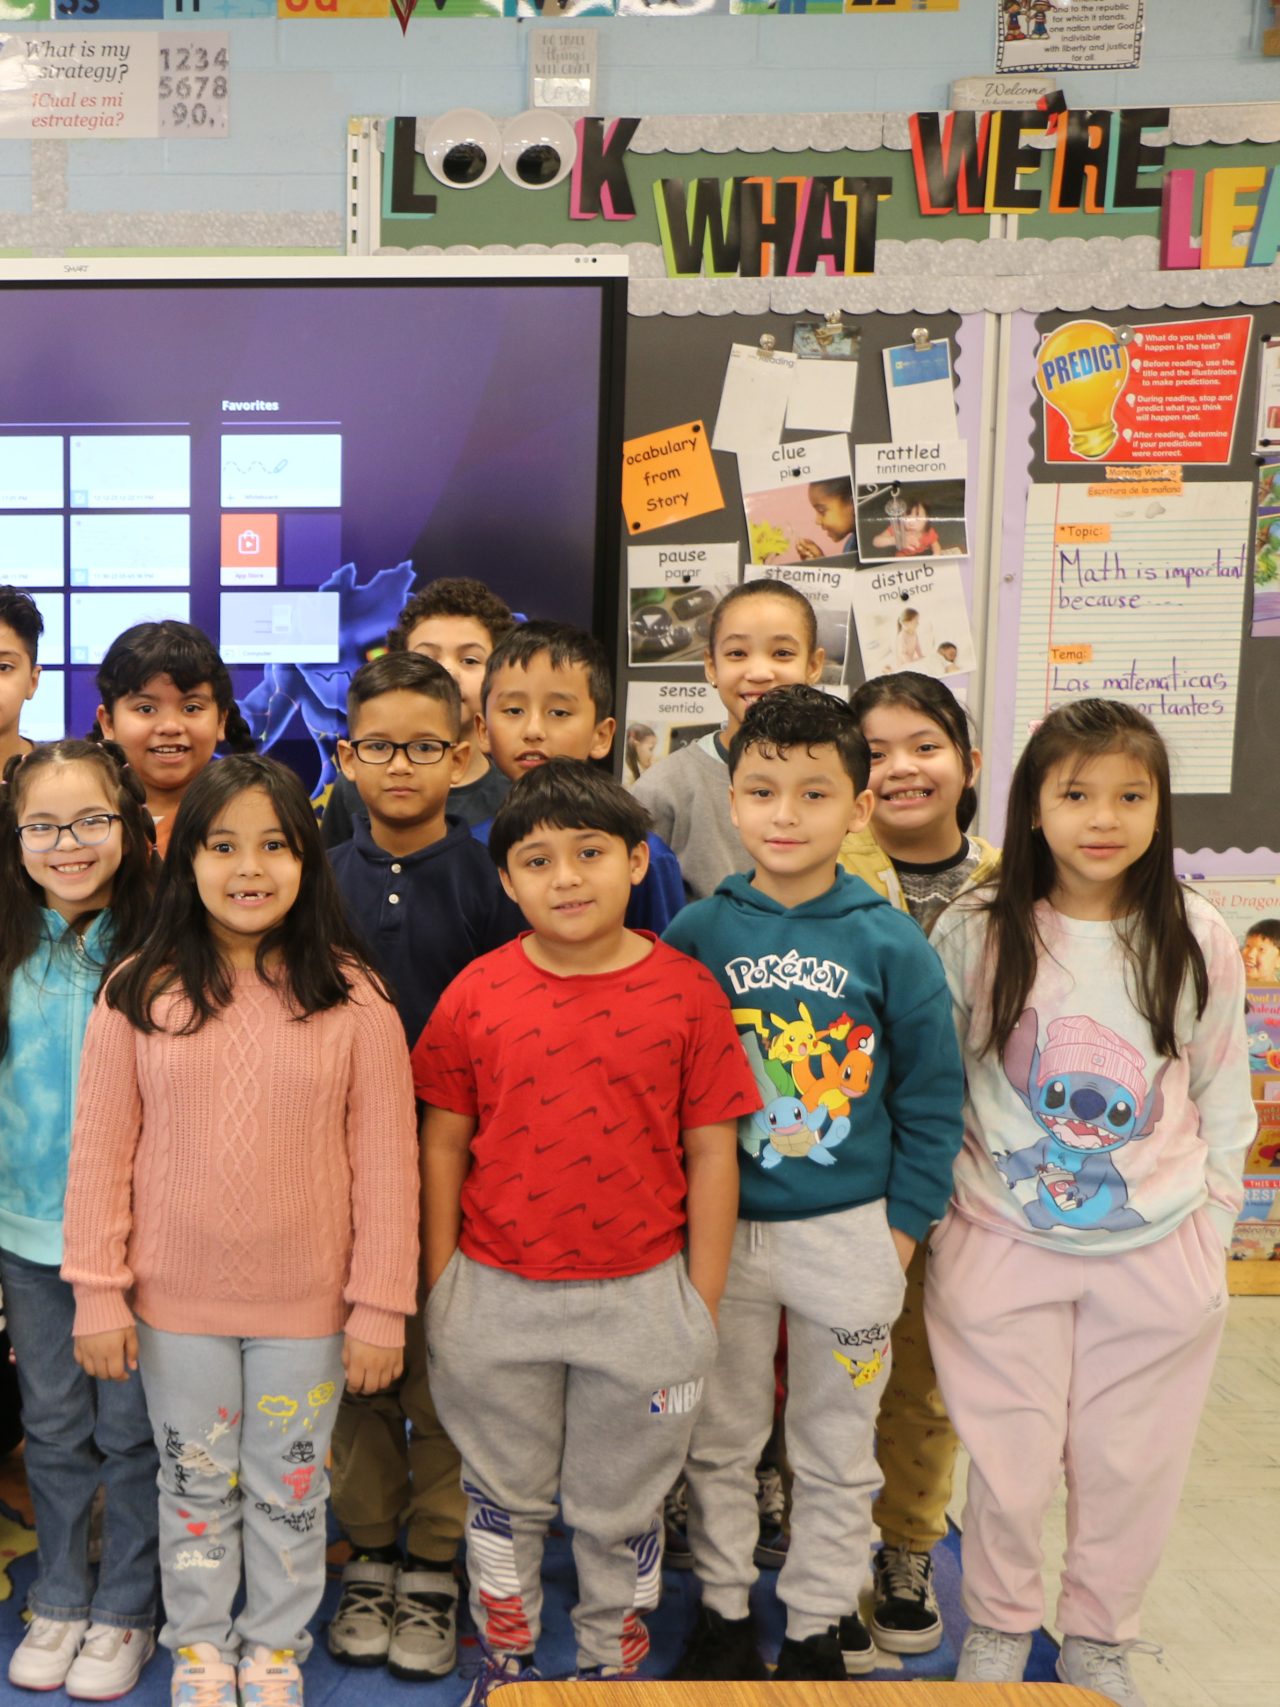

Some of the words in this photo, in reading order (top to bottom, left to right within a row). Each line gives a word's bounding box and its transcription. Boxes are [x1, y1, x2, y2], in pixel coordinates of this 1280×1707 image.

[1081, 4, 1093, 12] the
[1096, 3, 1130, 13] republic
[1053, 14, 1064, 22] for
[1066, 14, 1088, 22] which
[1067, 24, 1090, 32] nation
[1093, 23, 1115, 31] under
[1061, 33, 1100, 42] indivisible
[25, 40, 76, 58] What
[80, 42, 95, 58] is
[101, 44, 130, 60] my
[1045, 44, 1059, 52] with
[1062, 44, 1086, 53] liberty
[1089, 43, 1104, 51] and
[1106, 43, 1132, 52] justice
[159, 48, 229, 72] 1234
[1072, 54, 1082, 62] for
[38, 64, 128, 84] strategy?
[158, 76, 228, 99] 5678
[984, 83, 1047, 96] Welcome
[80, 95, 96, 108] es
[102, 92, 122, 108] mi
[32, 111, 124, 130] estrategia?
[653, 175, 893, 278] WHAT
[1159, 163, 1280, 271] LE
[1180, 335, 1194, 343] you
[1145, 343, 1174, 351] happen
[1043, 344, 1121, 390] PREDICT
[1175, 378, 1220, 386] predictions.
[1137, 395, 1165, 403] During
[1168, 394, 1197, 403] reading,
[222, 400, 279, 412] Favorites
[1137, 404, 1163, 412] predict
[1151, 414, 1178, 422] happen
[1154, 431, 1186, 439] reading,
[1159, 440, 1201, 448] predictions
[622, 436, 698, 466] ocabulary
[771, 445, 807, 463] clue
[877, 444, 941, 461] rattled
[779, 463, 811, 482] pia
[875, 461, 946, 474] tintinearon
[643, 467, 681, 486] from
[1088, 487, 1127, 495] Escritura
[1130, 487, 1140, 495] de
[1152, 485, 1181, 494] mañana
[646, 489, 690, 512] Story
[658, 549, 707, 563] pause
[1059, 548, 1126, 587] Math
[1137, 562, 1157, 579] is
[1165, 543, 1246, 588] important
[764, 567, 841, 588] steaming
[871, 563, 934, 590] disturb
[1052, 649, 1087, 660] Tema:
[1052, 667, 1090, 692] Las
[659, 686, 707, 697] sense
[658, 702, 704, 714] sentido
